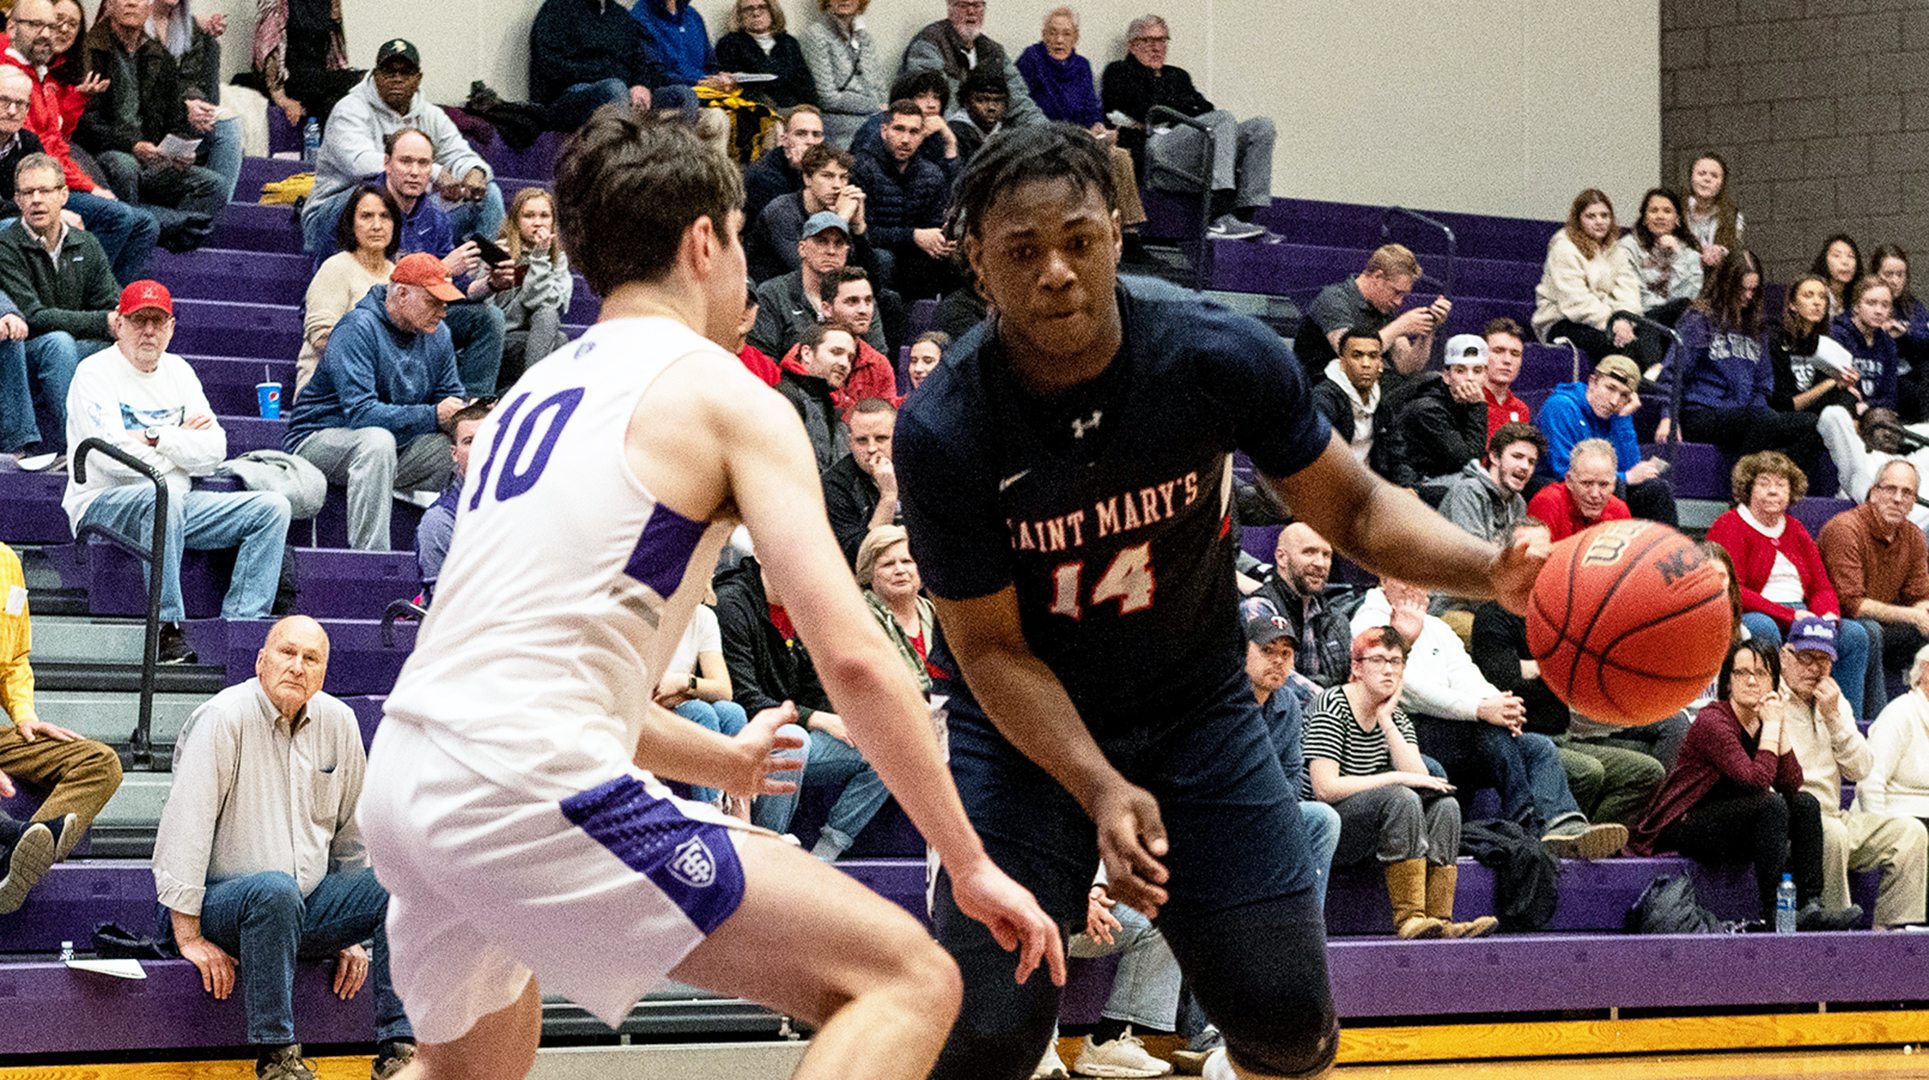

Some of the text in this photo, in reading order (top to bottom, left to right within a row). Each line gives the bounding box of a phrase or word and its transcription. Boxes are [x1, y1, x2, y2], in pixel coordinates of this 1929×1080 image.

[469, 386, 586, 512] 10
[1094, 470, 1199, 539] MARY'S
[1049, 540, 1157, 622] 14
